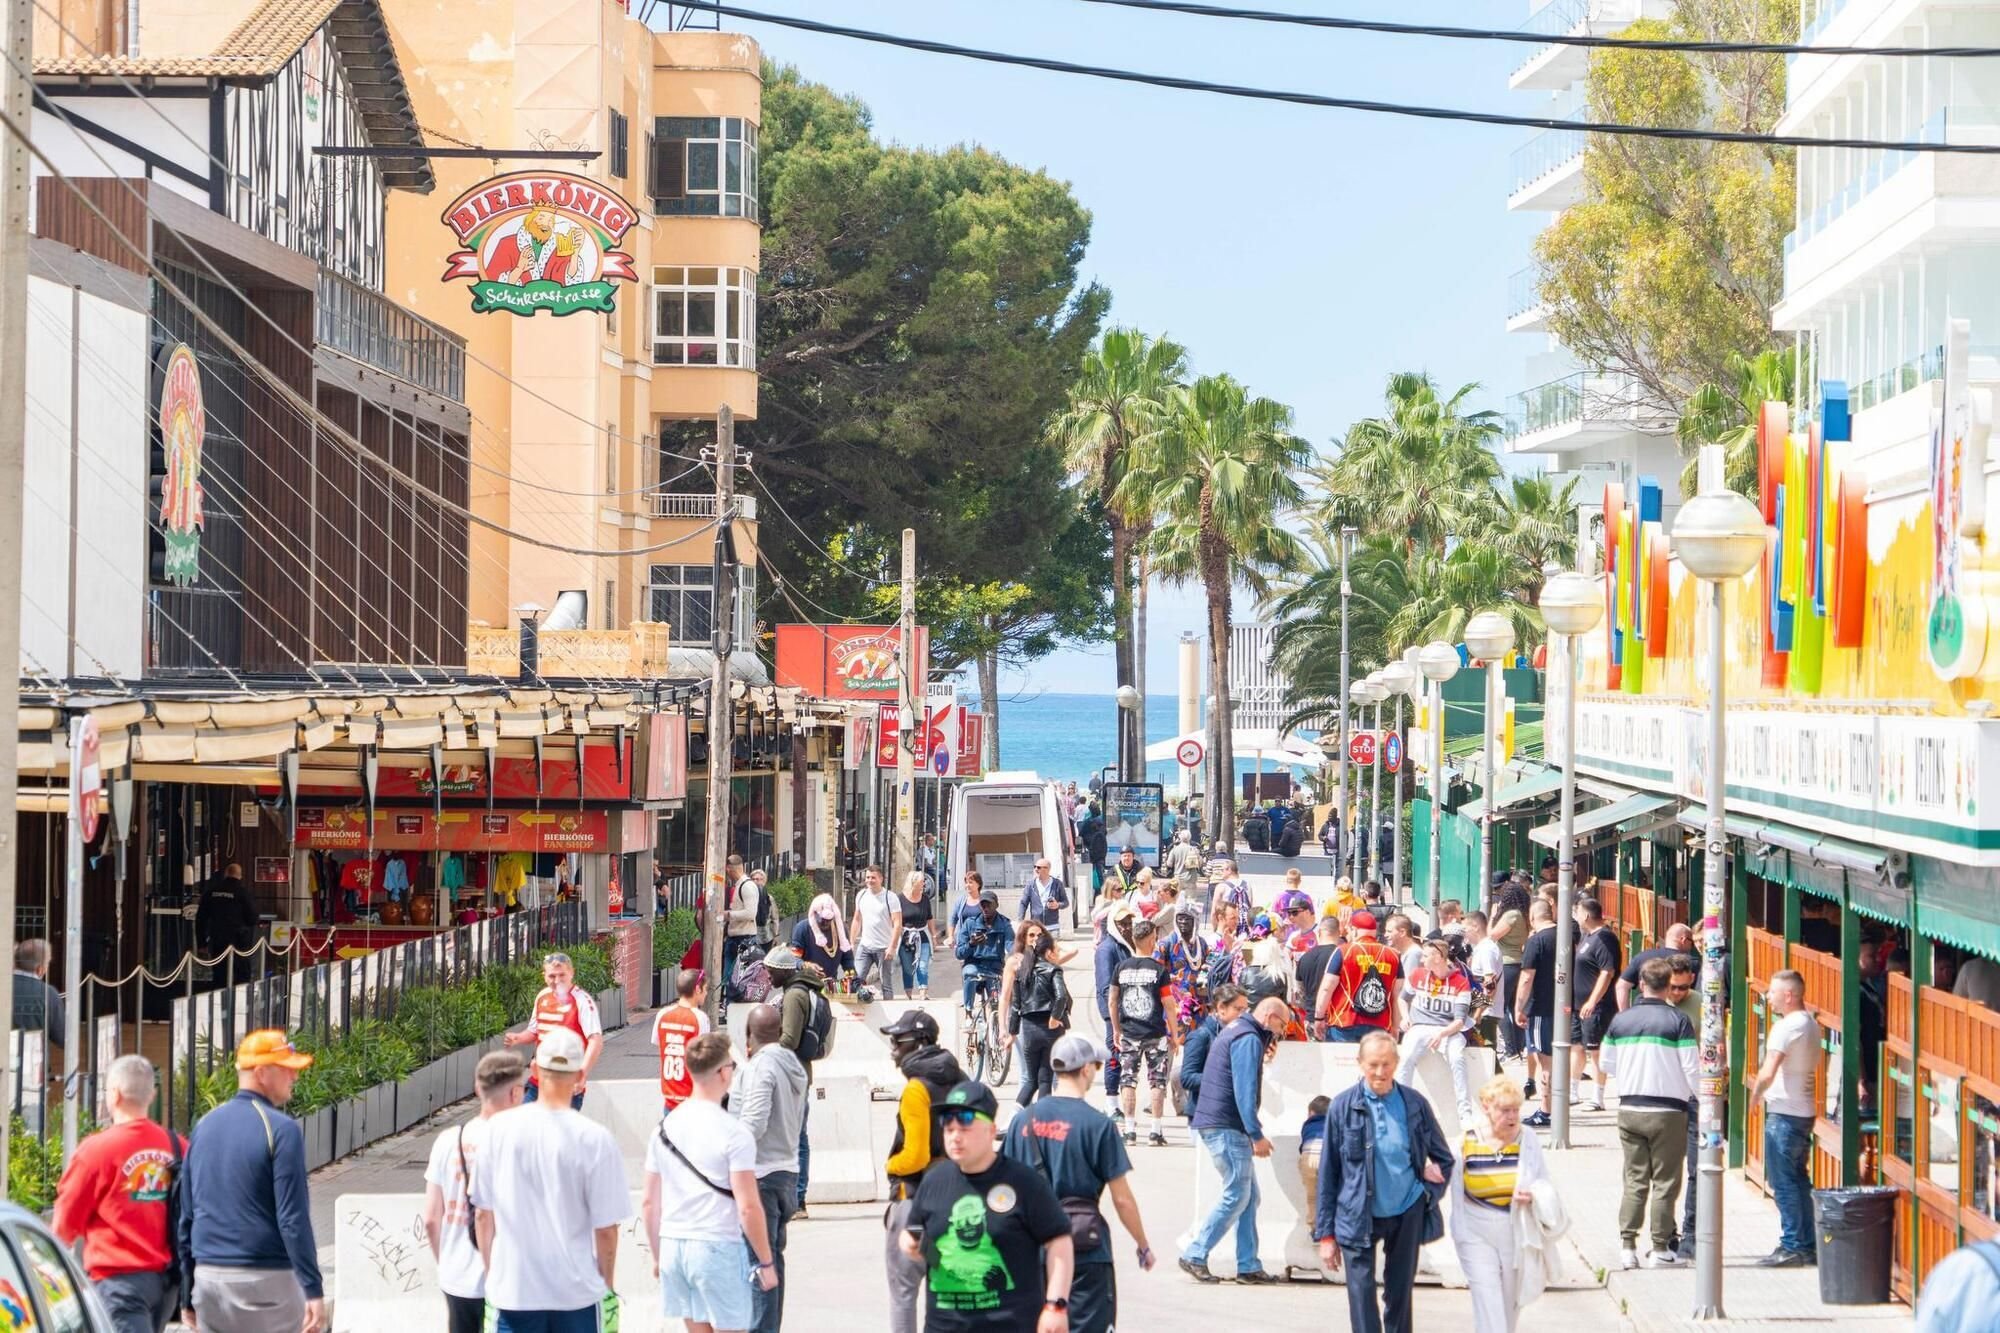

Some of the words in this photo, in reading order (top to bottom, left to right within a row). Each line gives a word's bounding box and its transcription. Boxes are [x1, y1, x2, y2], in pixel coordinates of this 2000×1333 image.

[452, 180, 627, 233] BIERKÖNIG
[486, 288, 602, 306] Schinkenstrasse
[311, 830, 361, 838] BIERKÖNIG
[544, 832, 594, 841] BIERKÖNIG
[663, 1055, 685, 1081] 03
